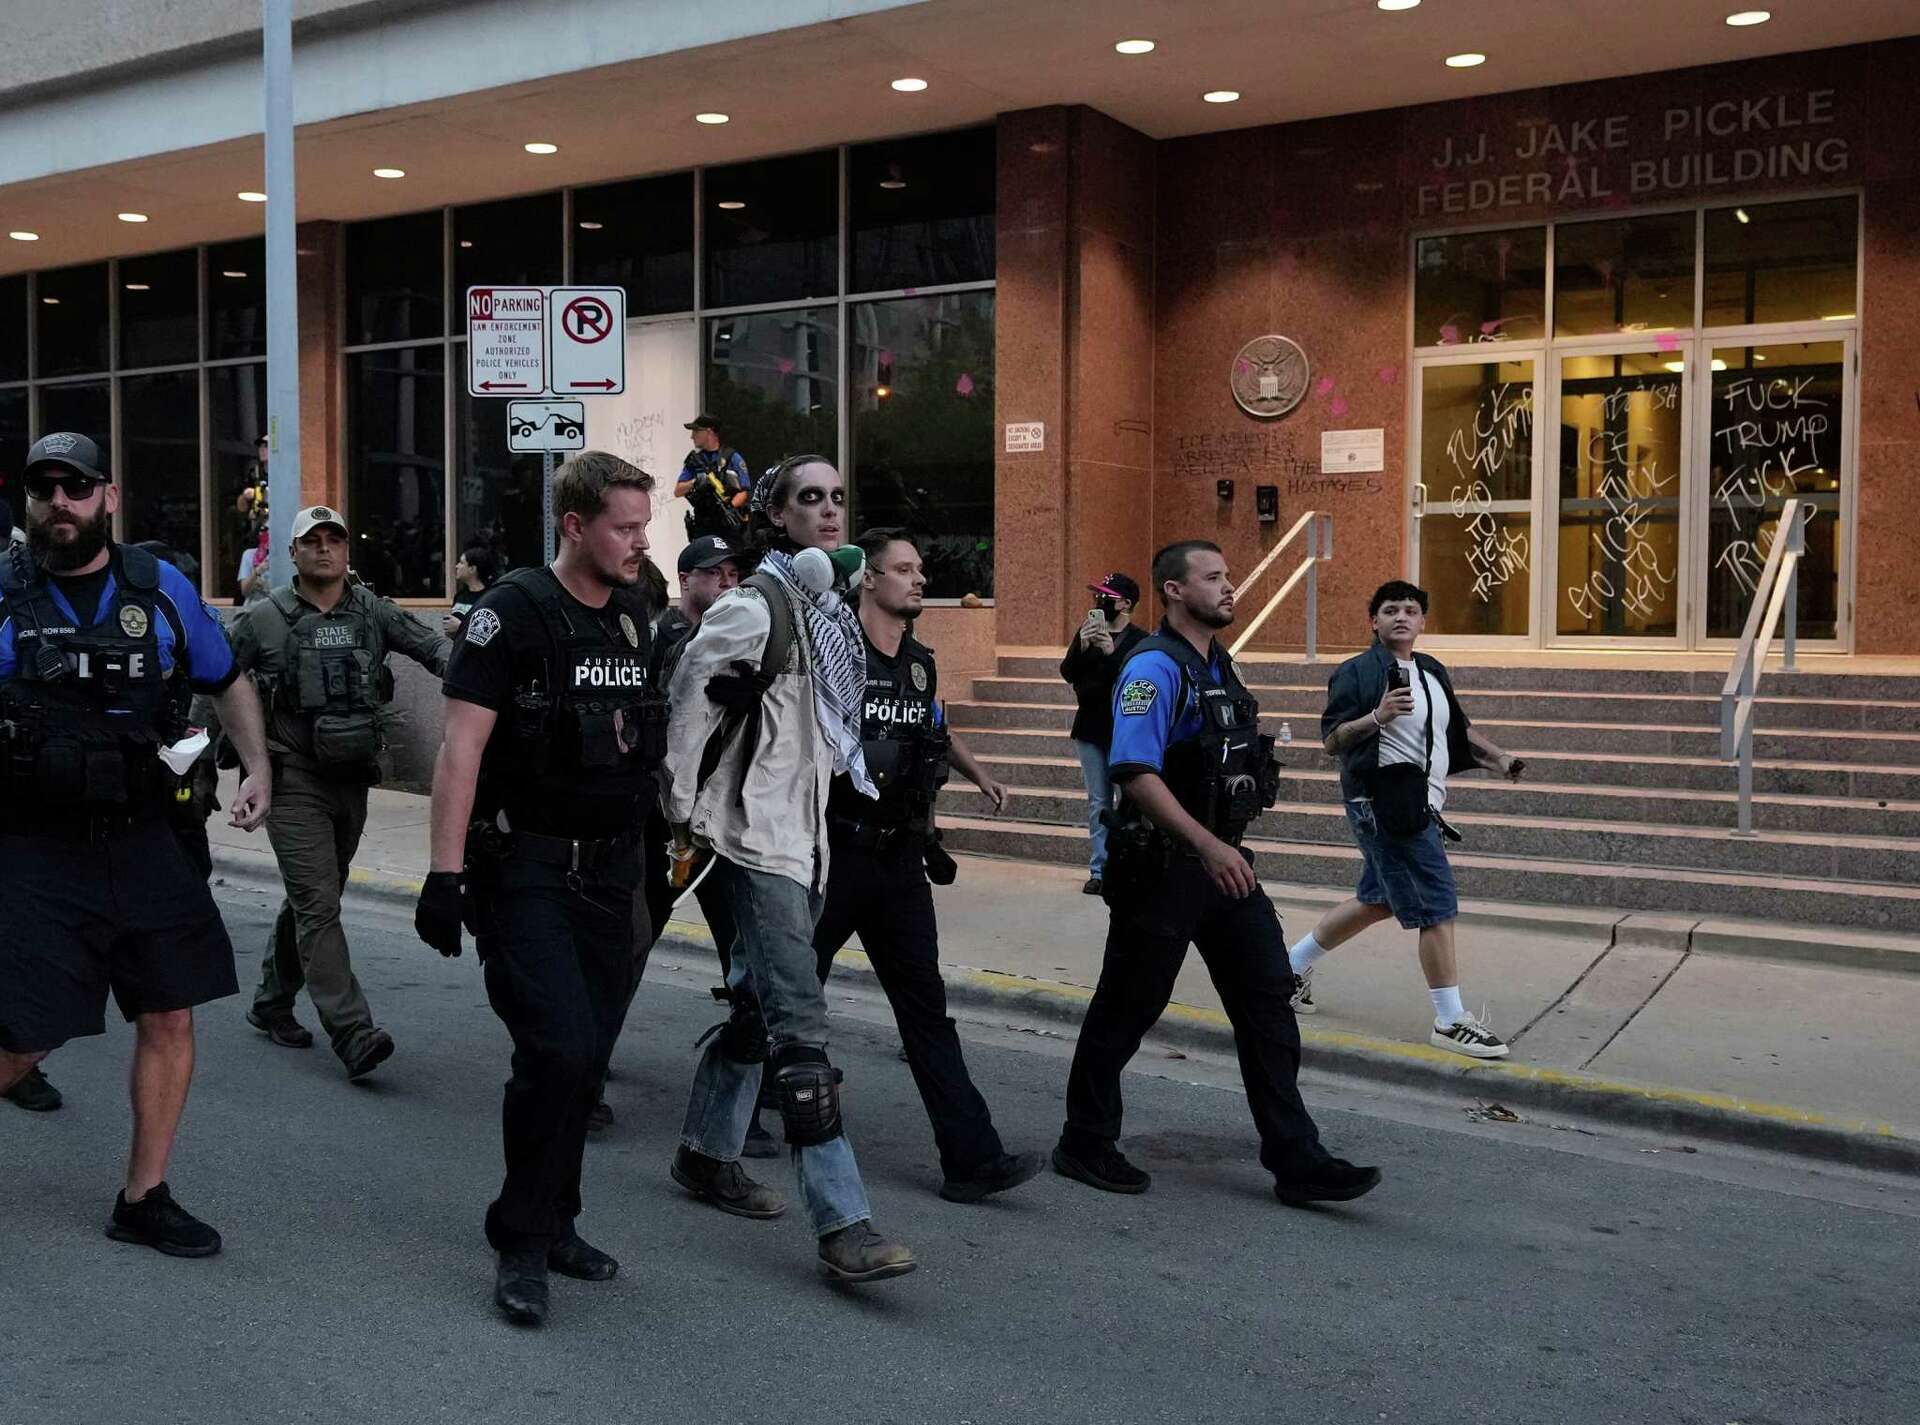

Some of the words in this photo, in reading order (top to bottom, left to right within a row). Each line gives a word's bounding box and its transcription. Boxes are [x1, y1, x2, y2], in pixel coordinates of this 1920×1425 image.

[1432, 132, 1494, 169] J.J.
[1516, 115, 1630, 160] JAKE
[1664, 89, 1835, 141] PICKLE
[1417, 166, 1612, 217] FEDERAL
[1630, 137, 1849, 193] BUILDING
[470, 294, 492, 316] NO
[494, 298, 541, 312] PARKING
[473, 322, 487, 332] LAW
[490, 322, 541, 332] ENFORCEMENT
[498, 334, 517, 344] ZONE
[485, 346, 530, 356] AUTHORIZED
[476, 358, 501, 368] POLICE
[505, 358, 540, 368] VEHICLES
[498, 371, 517, 380] ONLY
[1724, 376, 1828, 411] FUCK
[1715, 414, 1828, 464] TRUMP
[1715, 447, 1818, 531] FUCK
[316, 625, 348, 637] STATE
[315, 635, 353, 648] POLICE
[584, 657, 635, 666] AUSTIN
[575, 665, 642, 686] POLICE
[873, 697, 922, 708] AUSTIN
[865, 702, 926, 724] POLICE
